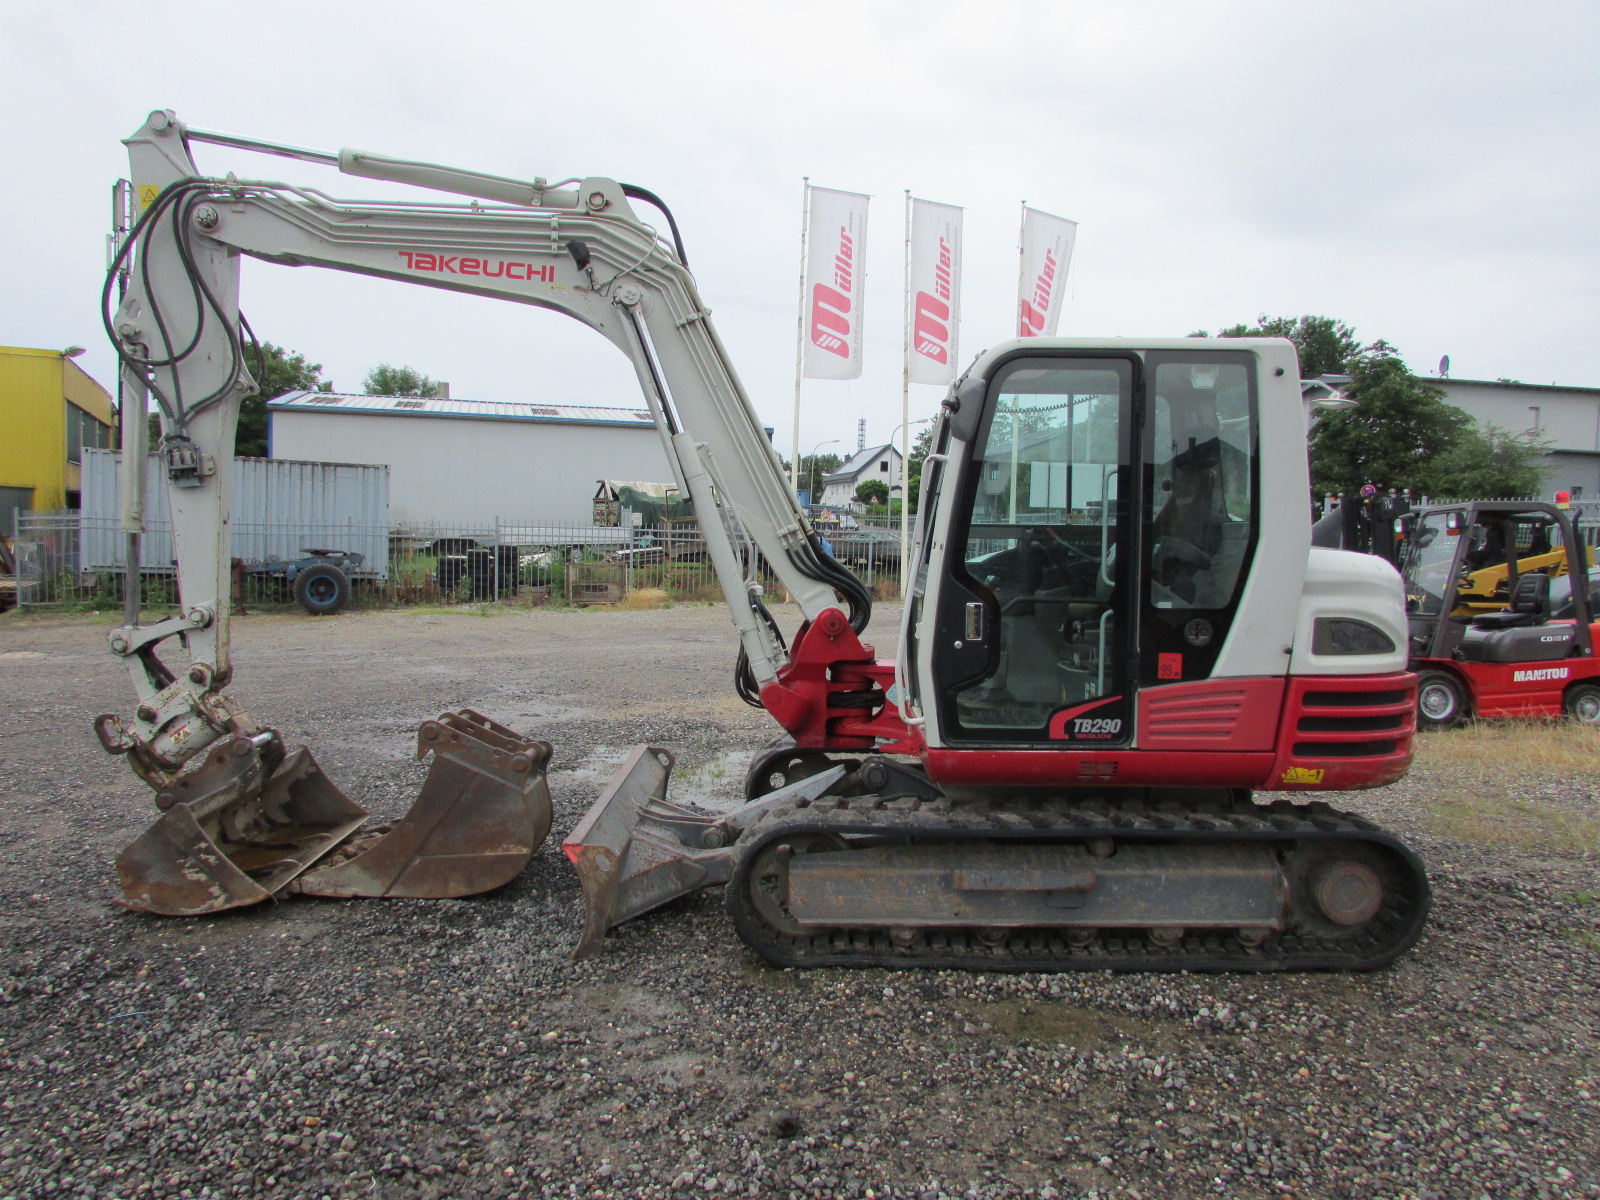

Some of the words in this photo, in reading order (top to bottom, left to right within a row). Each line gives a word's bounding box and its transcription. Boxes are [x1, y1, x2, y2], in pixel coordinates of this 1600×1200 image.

[398, 251, 555, 282] TAKEUCHI
[811, 226, 853, 359] Müller
[914, 237, 951, 365] Müller
[1160, 664, 1172, 677] 99
[1513, 667, 1568, 682] MANITOU
[1073, 718, 1122, 733] TB290
